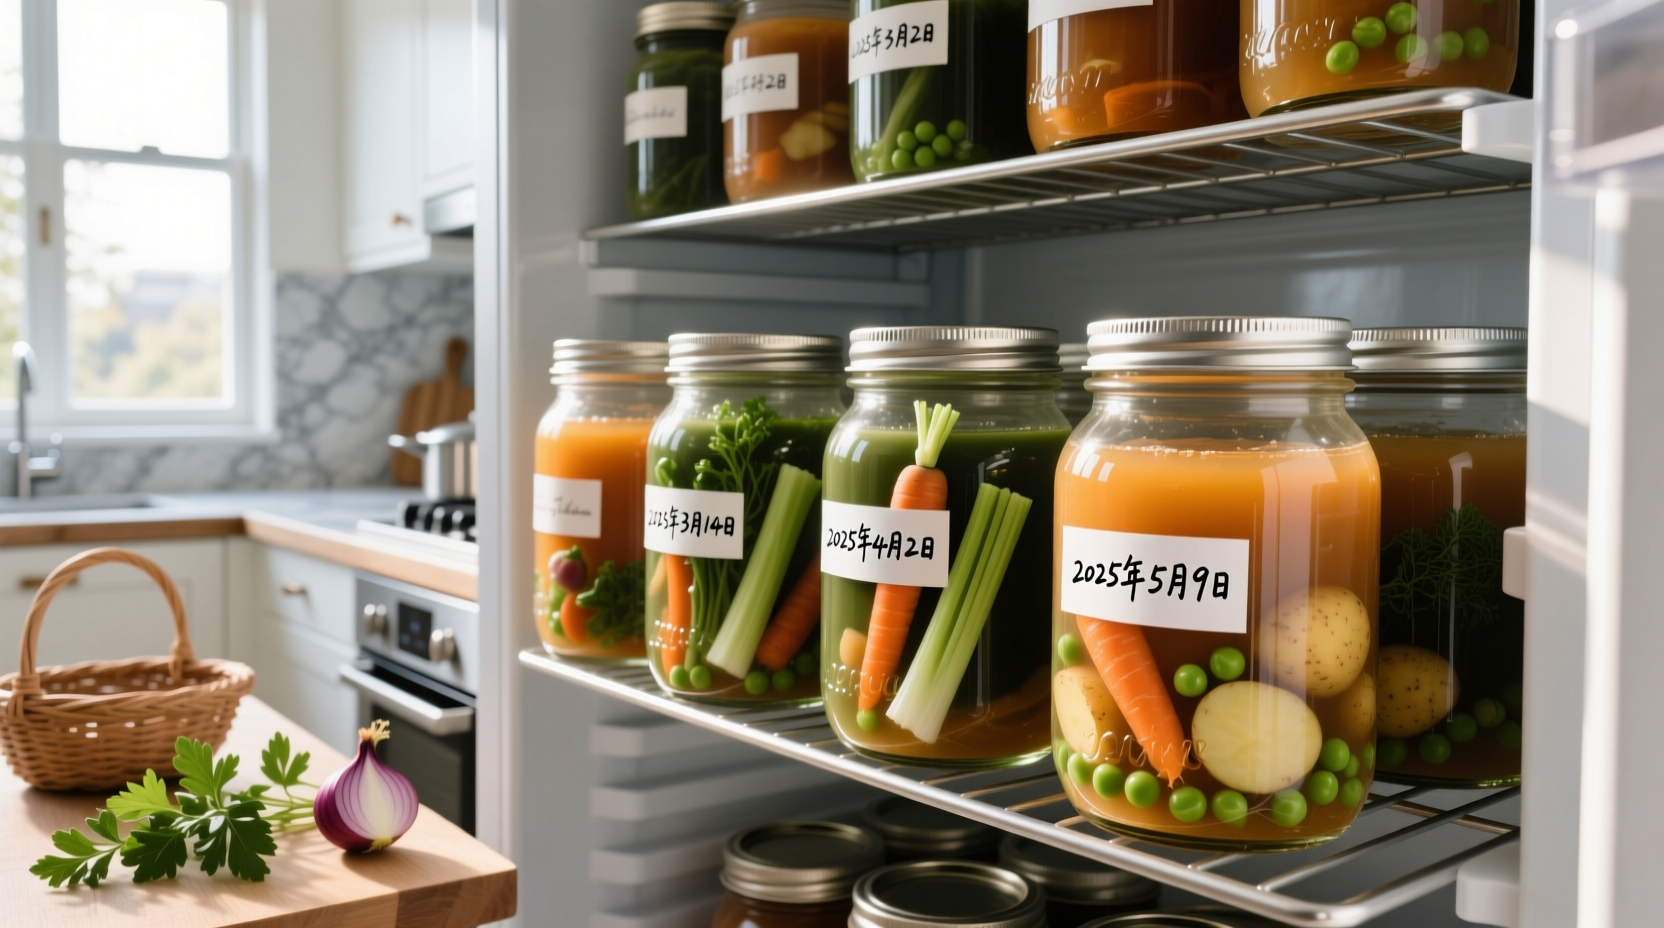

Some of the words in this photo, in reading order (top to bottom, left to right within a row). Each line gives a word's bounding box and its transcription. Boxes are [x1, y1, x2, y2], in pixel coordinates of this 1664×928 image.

[648, 504, 735, 541] 2025年3月14日
[826, 522, 935, 563] 2025年4月2日
[1072, 554, 1229, 602] 2025年5月9日
